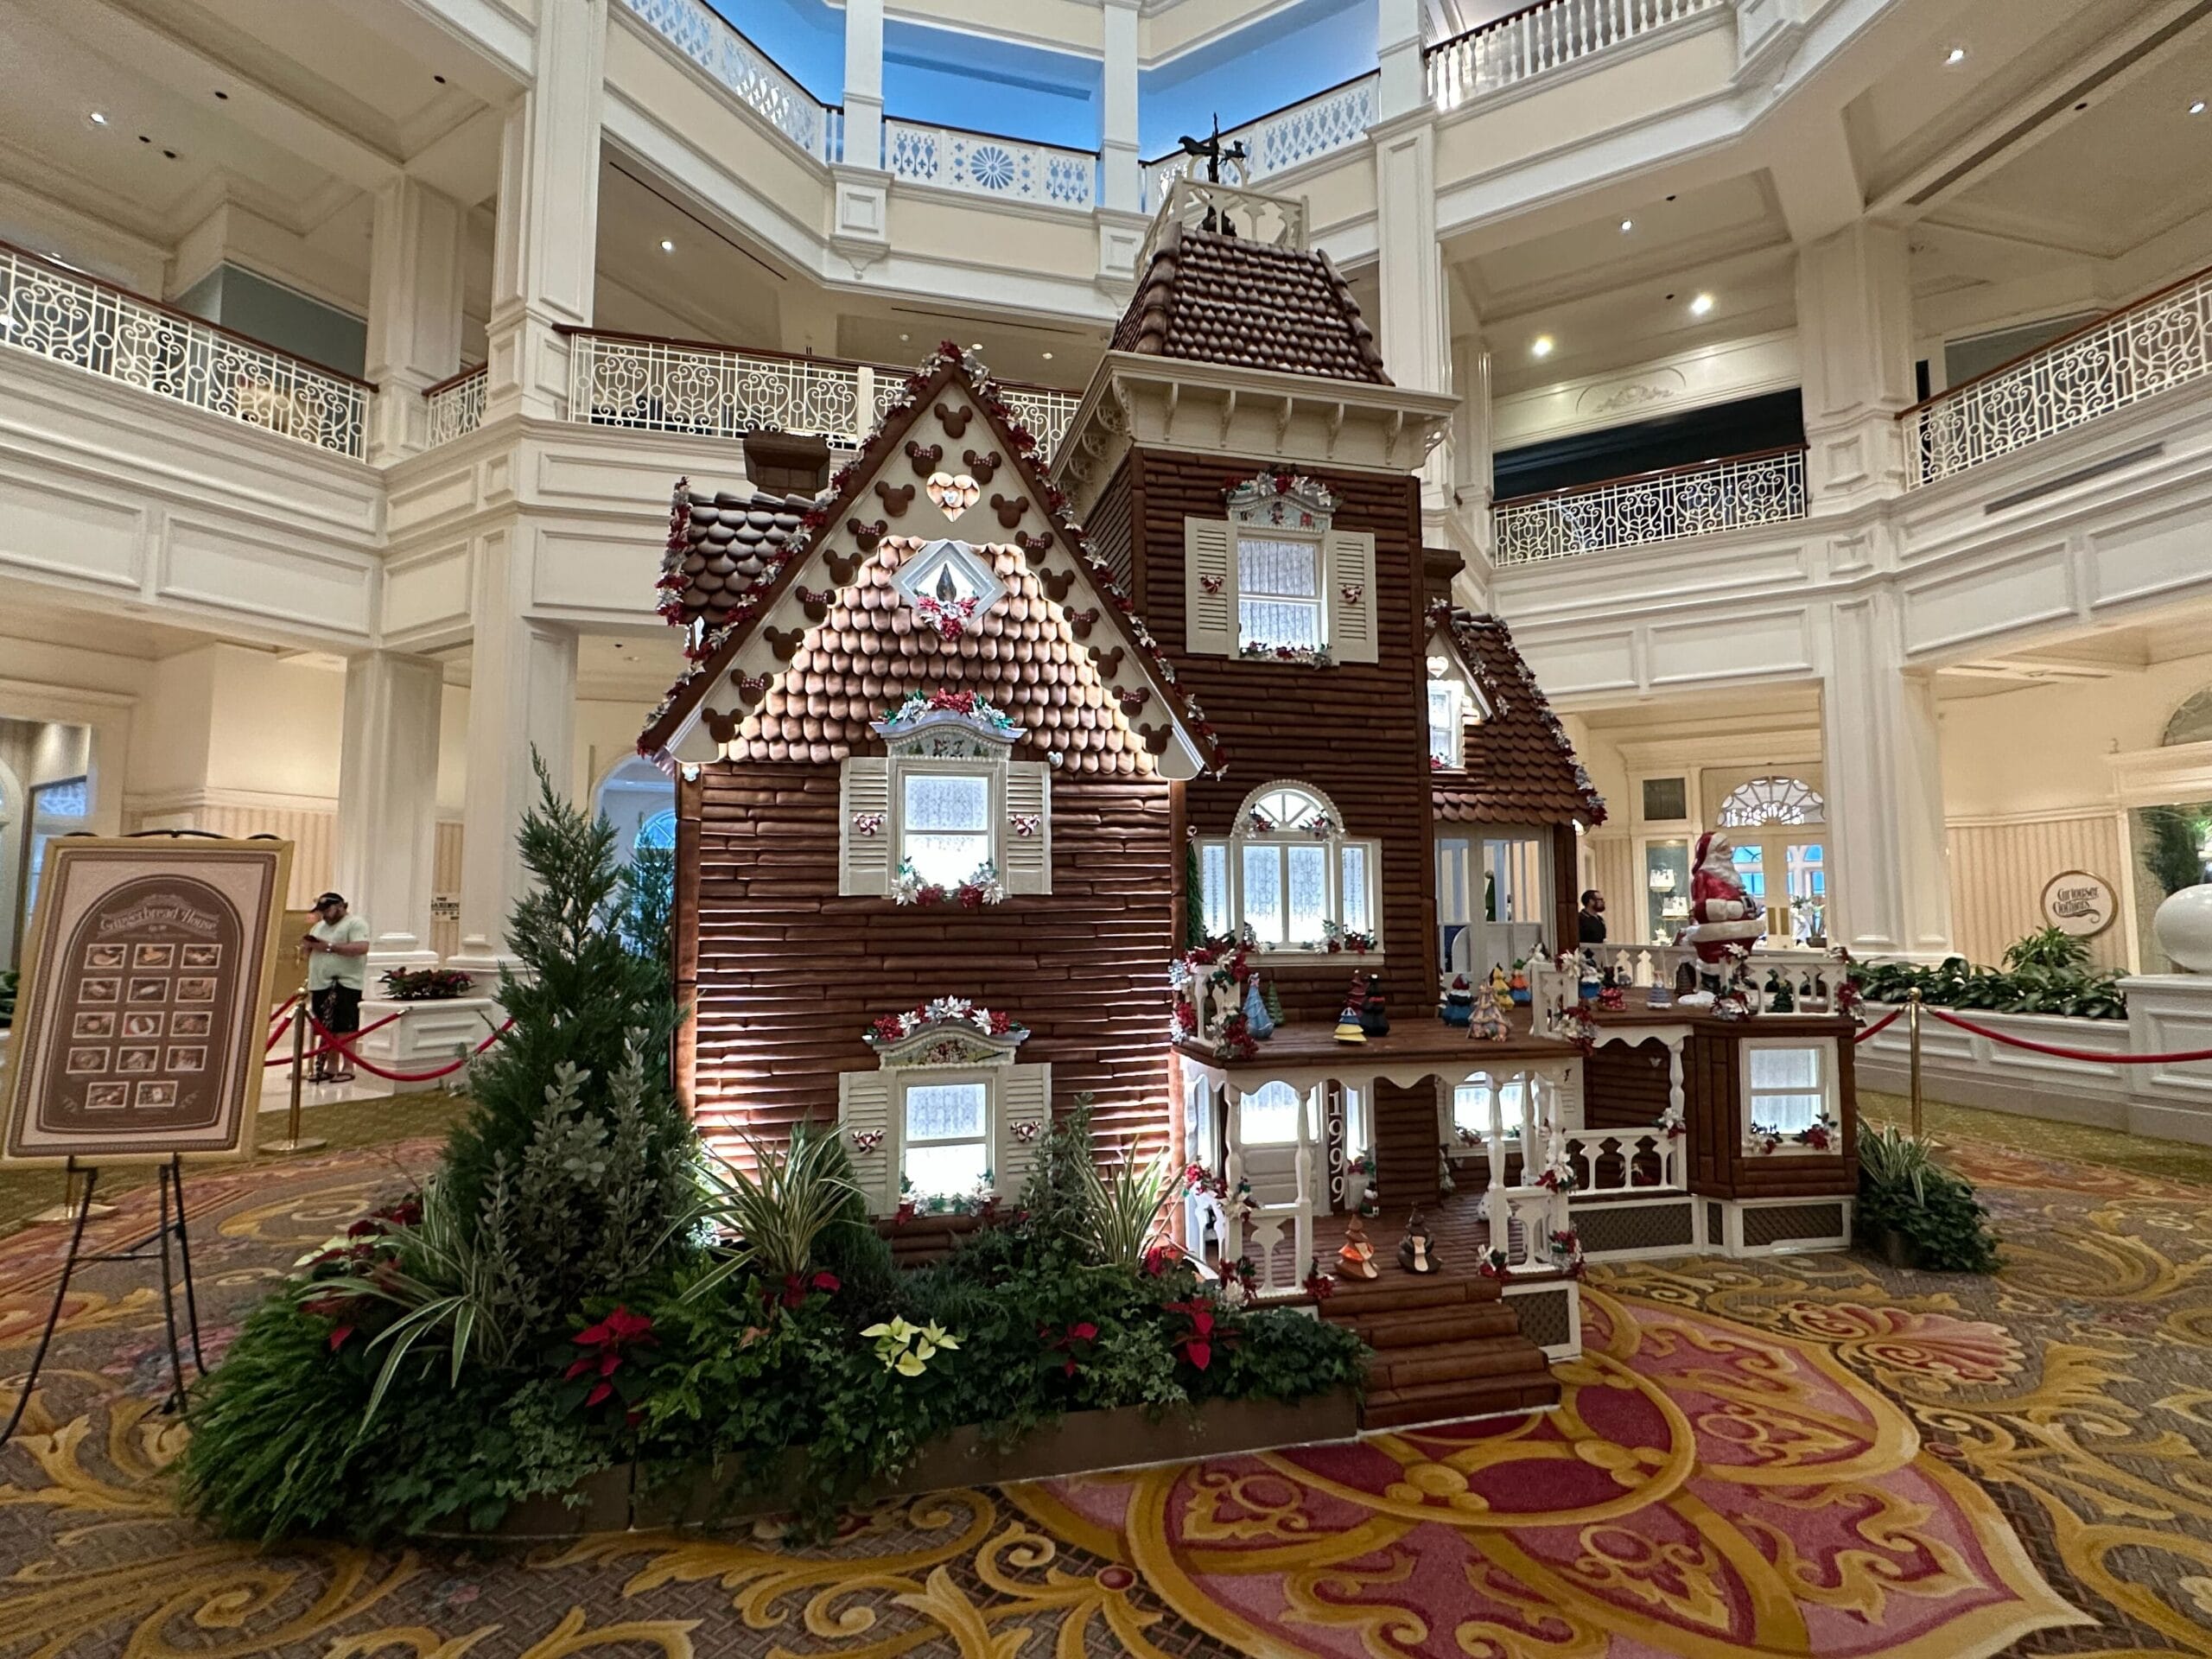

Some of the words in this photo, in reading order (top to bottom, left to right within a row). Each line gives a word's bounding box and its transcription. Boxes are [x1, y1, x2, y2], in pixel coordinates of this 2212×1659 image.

[100, 906, 179, 931] Gingerbread
[181, 908, 217, 930] House
[1329, 1090, 1344, 1203] 1999
